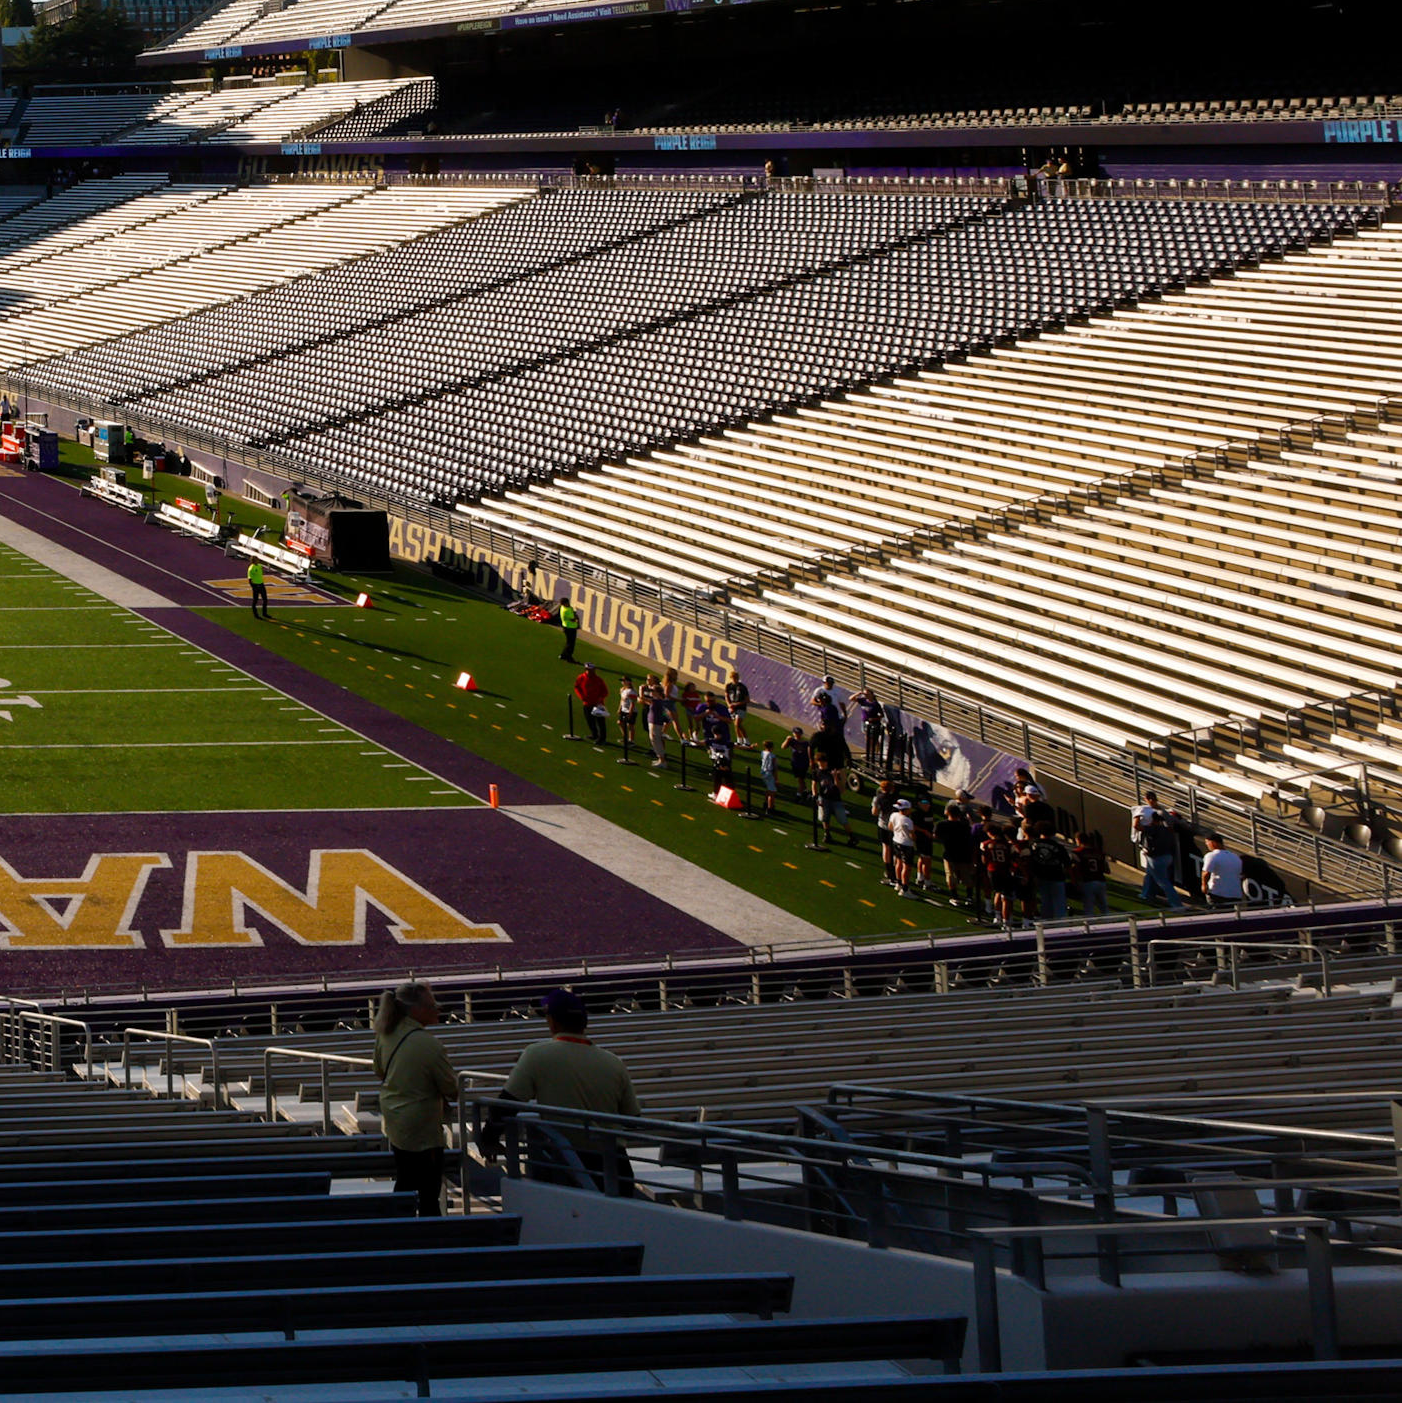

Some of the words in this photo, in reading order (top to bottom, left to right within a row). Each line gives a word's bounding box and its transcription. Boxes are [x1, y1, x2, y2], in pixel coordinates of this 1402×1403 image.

[654, 135, 689, 150] PURPLE
[689, 135, 717, 150] REIGN
[1323, 120, 1394, 143] PURPLE
[571, 583, 738, 689] HUSKIES
